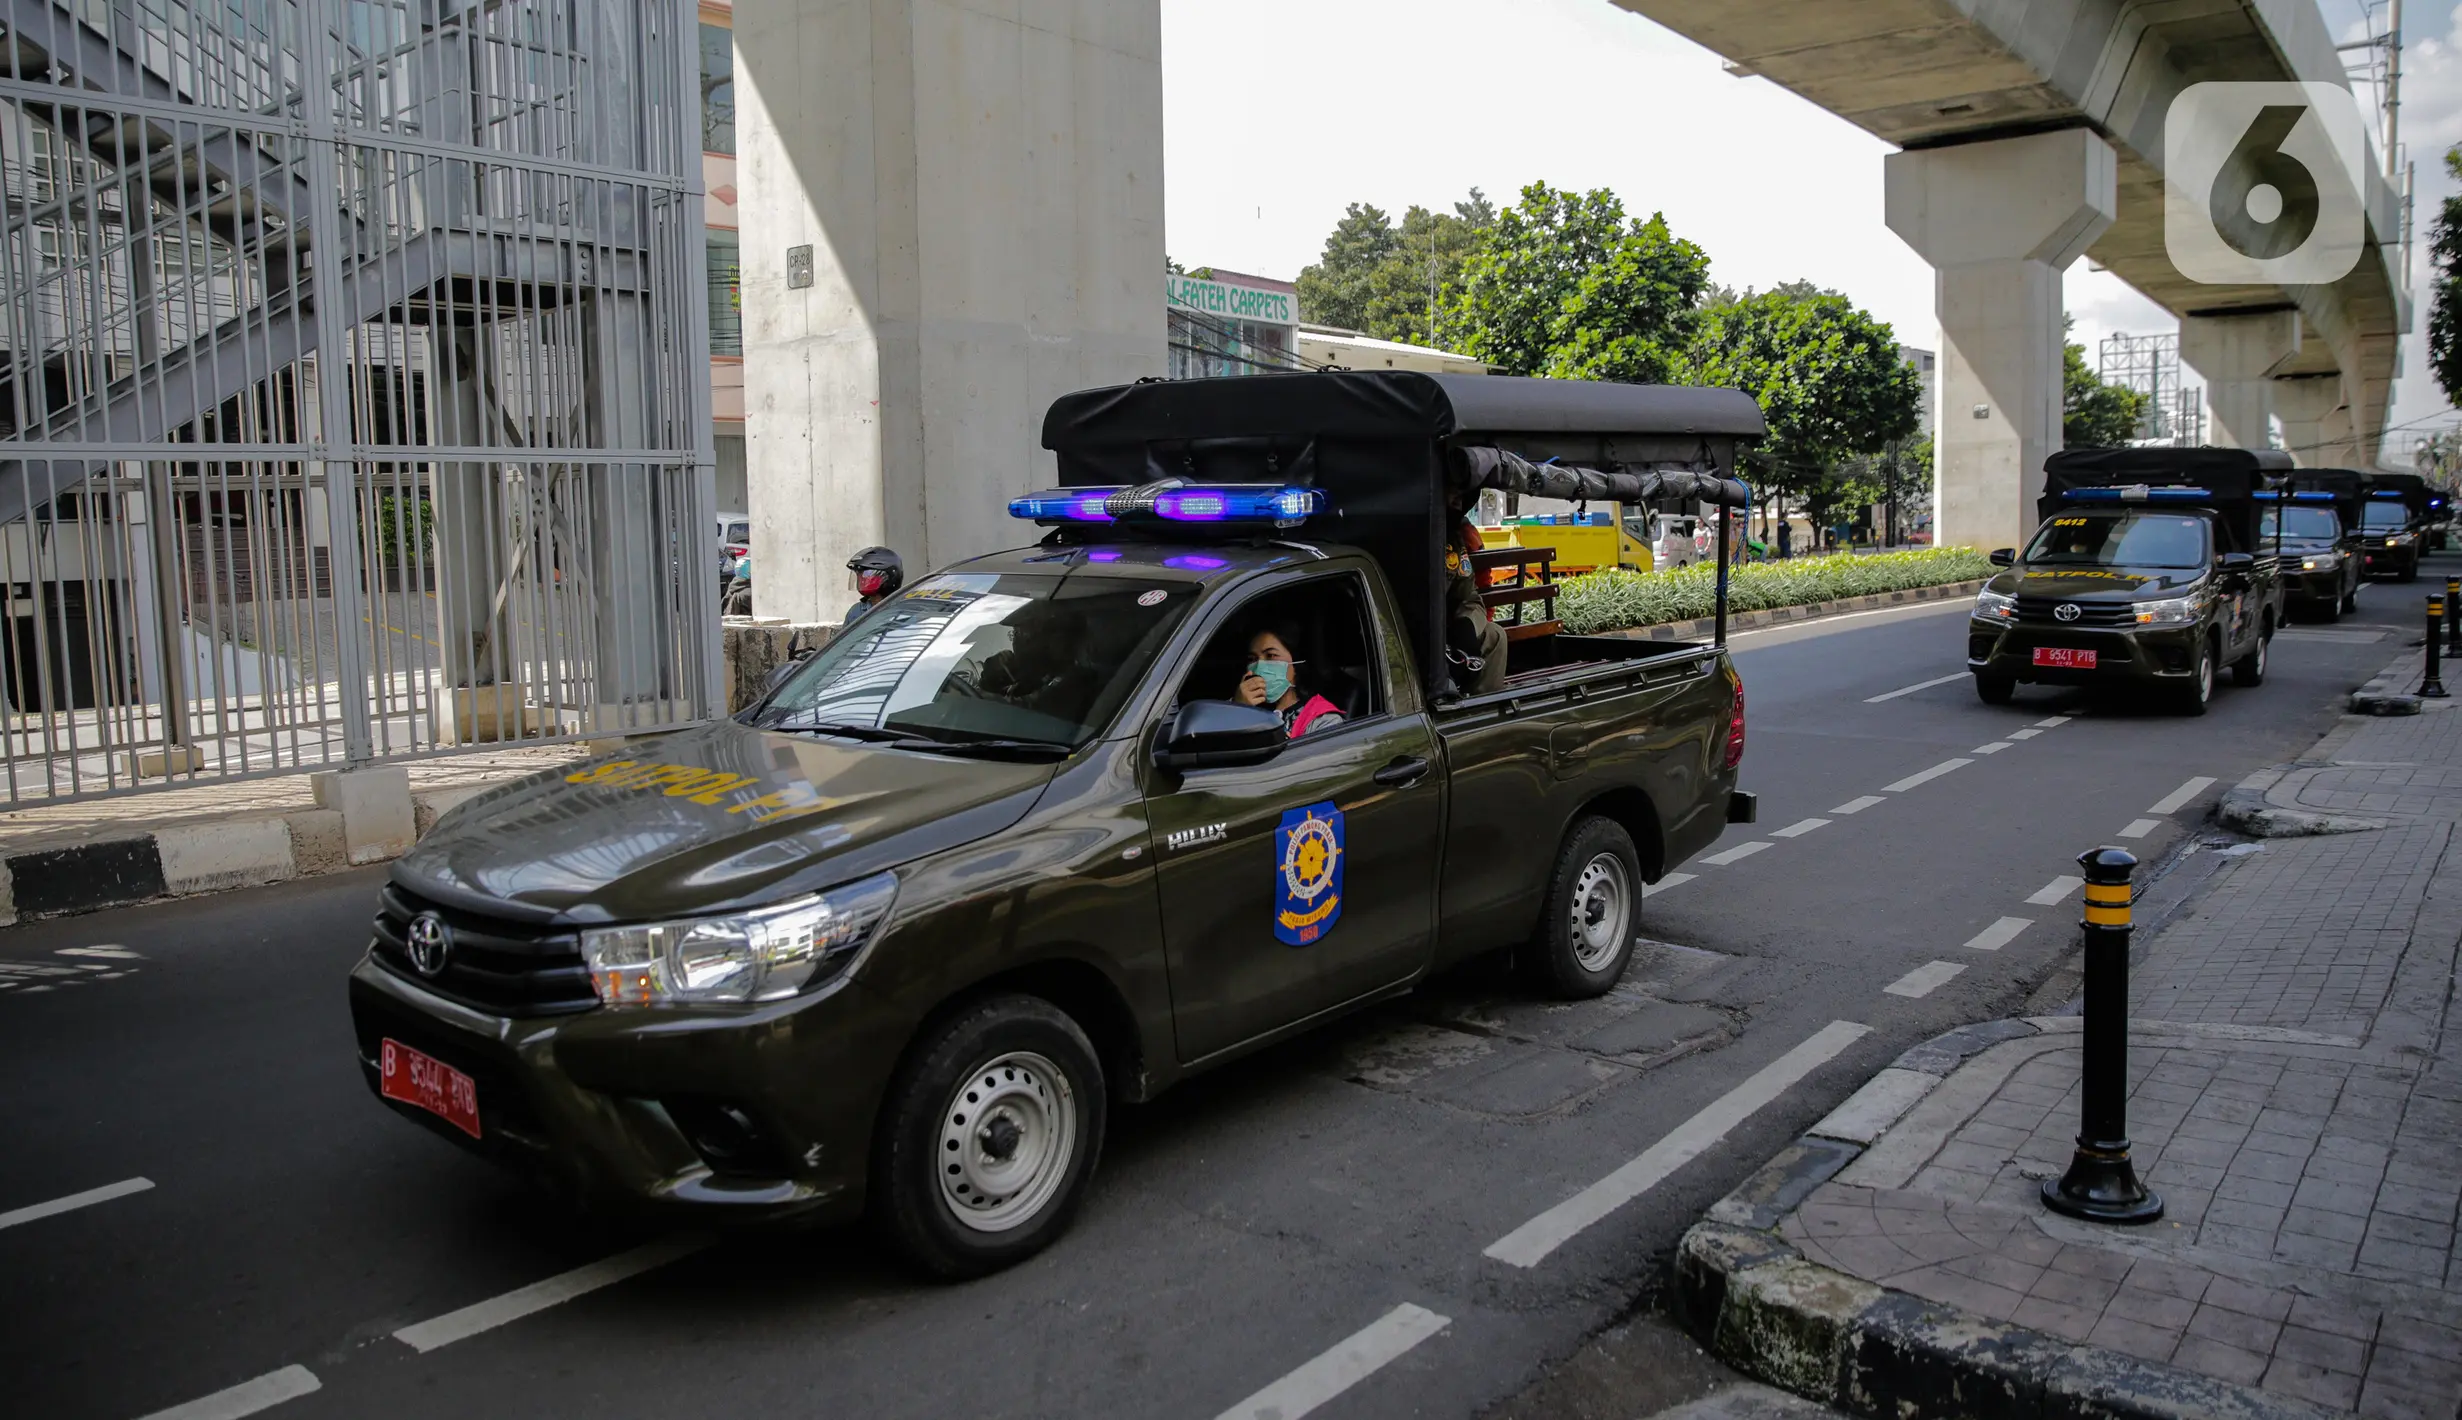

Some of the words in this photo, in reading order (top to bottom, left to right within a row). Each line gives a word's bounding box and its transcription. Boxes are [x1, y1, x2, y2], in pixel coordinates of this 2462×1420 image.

[1229, 287, 1289, 321] CARPETS
[2054, 518, 2087, 526] 5412
[2023, 570, 2118, 579] SATPOL
[2034, 648, 2041, 660] B
[2049, 649, 2072, 661] 9541
[2077, 651, 2096, 662] PTB
[565, 761, 760, 805] SATPOL
[1167, 821, 1228, 851] HILUX
[1300, 925, 1319, 942] 1950
[385, 1044, 396, 1077] B
